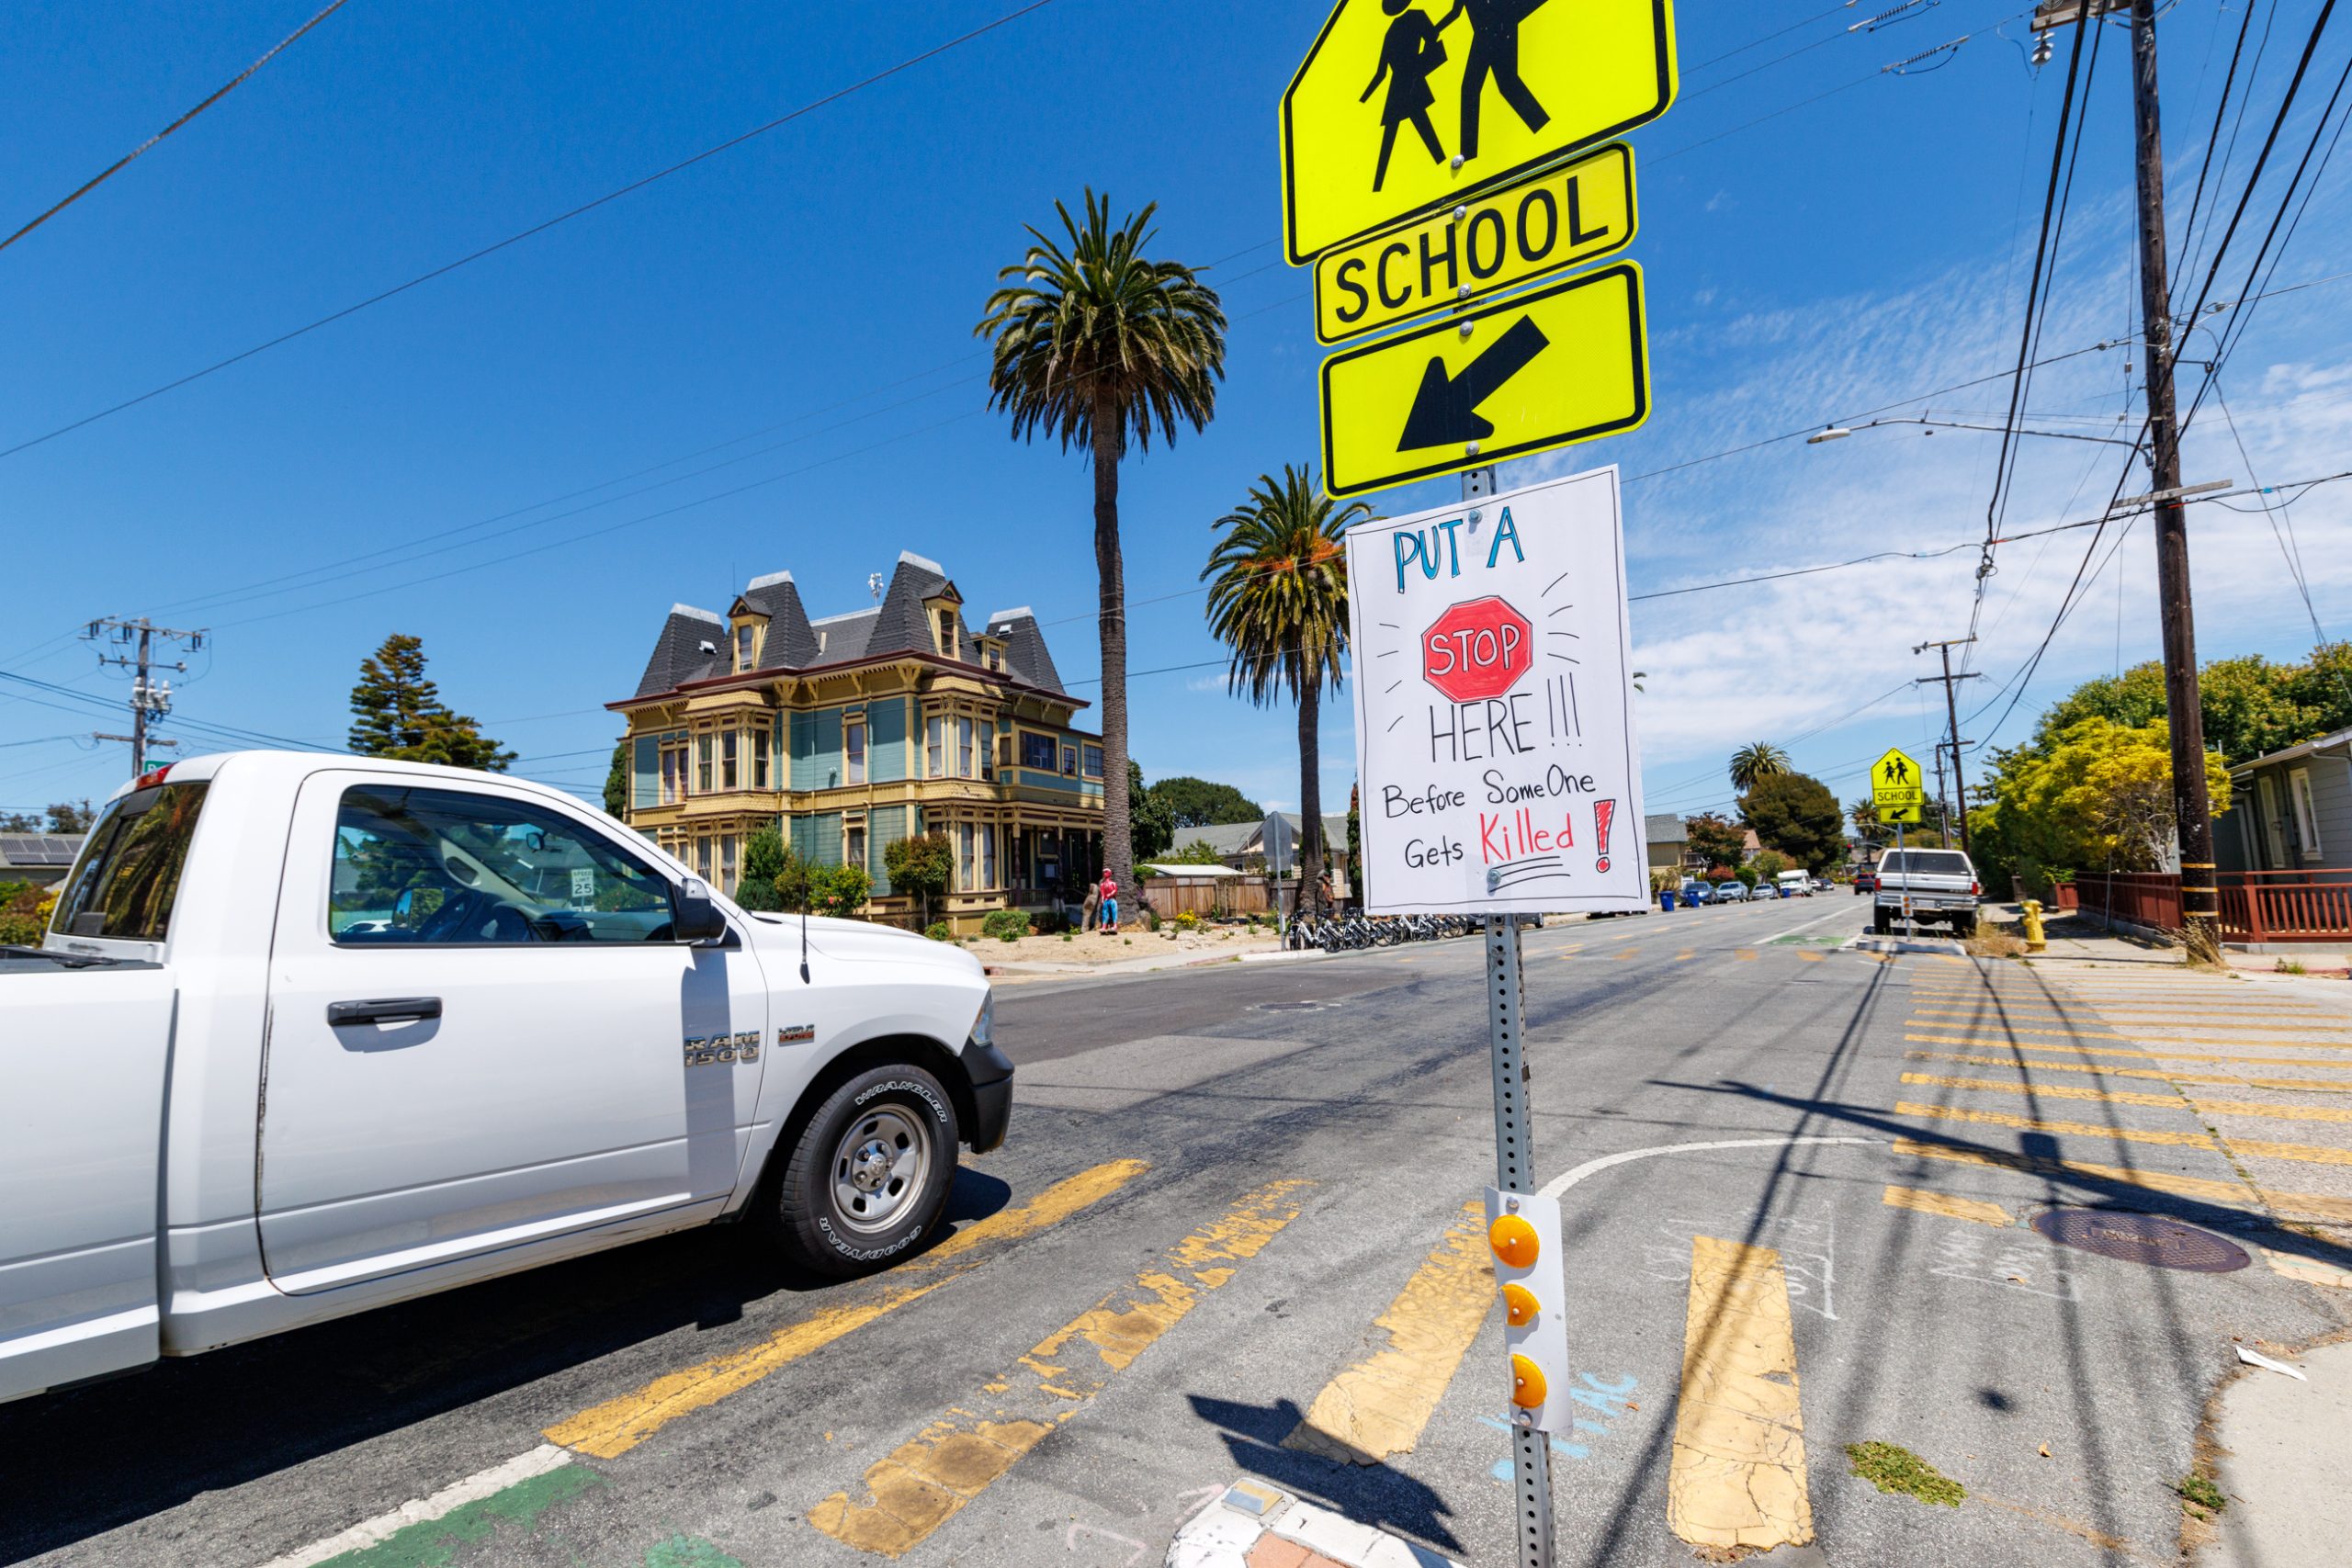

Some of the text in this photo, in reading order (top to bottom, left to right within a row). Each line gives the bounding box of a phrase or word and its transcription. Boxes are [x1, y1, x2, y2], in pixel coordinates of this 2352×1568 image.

[1336, 175, 1609, 323] SCHOOL
[1394, 506, 1525, 594] PUT A
[1429, 624, 1521, 675] STOP
[1383, 784, 1465, 818] Before
[1877, 791, 1918, 802] SCHOOL
[1405, 835, 1464, 868] Gets
[574, 884, 593, 895] 25
[684, 1030, 760, 1051] RAM
[684, 1045, 760, 1067] 1500
[854, 1081, 947, 1123] WRANGLER
[820, 1217, 922, 1261] GOODYEAR
